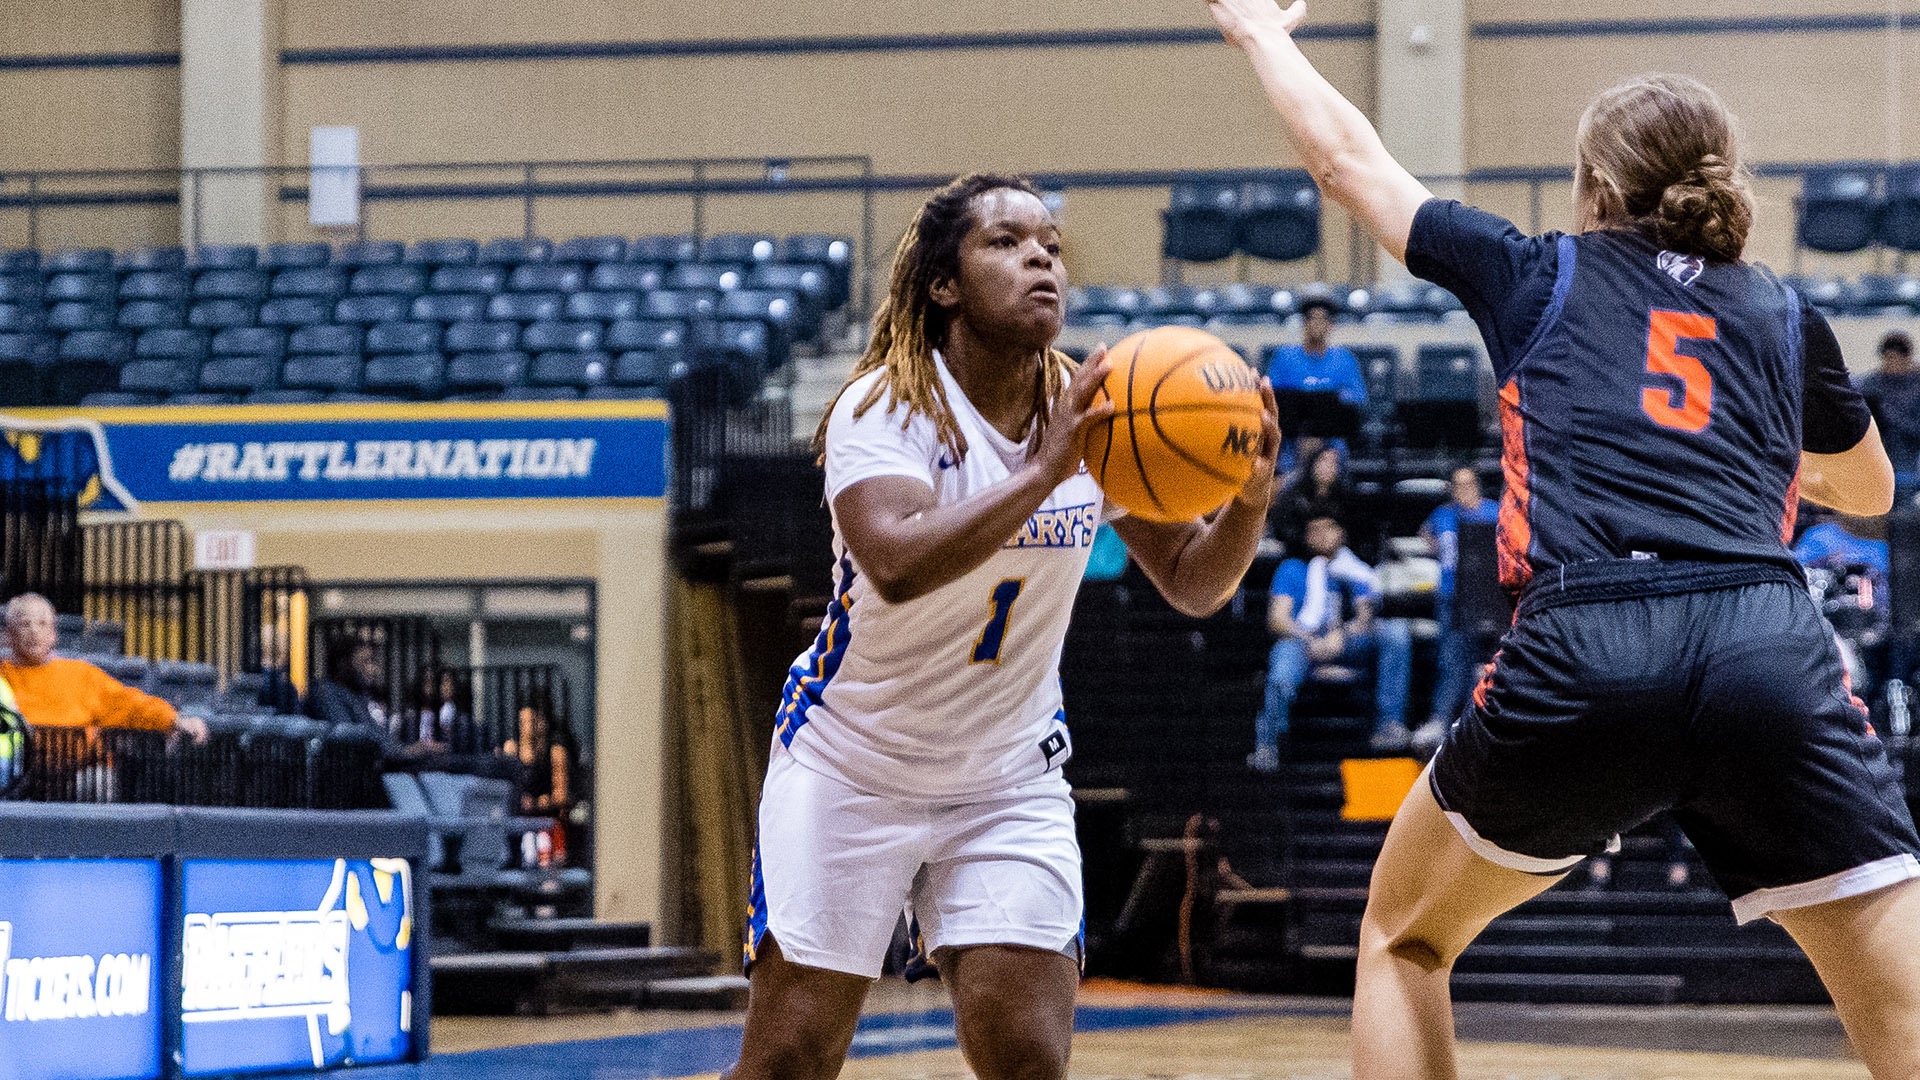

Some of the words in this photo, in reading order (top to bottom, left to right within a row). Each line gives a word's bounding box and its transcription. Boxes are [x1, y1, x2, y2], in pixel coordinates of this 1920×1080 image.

[1642, 309, 1717, 433] 5
[169, 438, 597, 482] #RATTLERNATION
[1006, 505, 1095, 546] ARY'S
[968, 577, 1026, 665] 1
